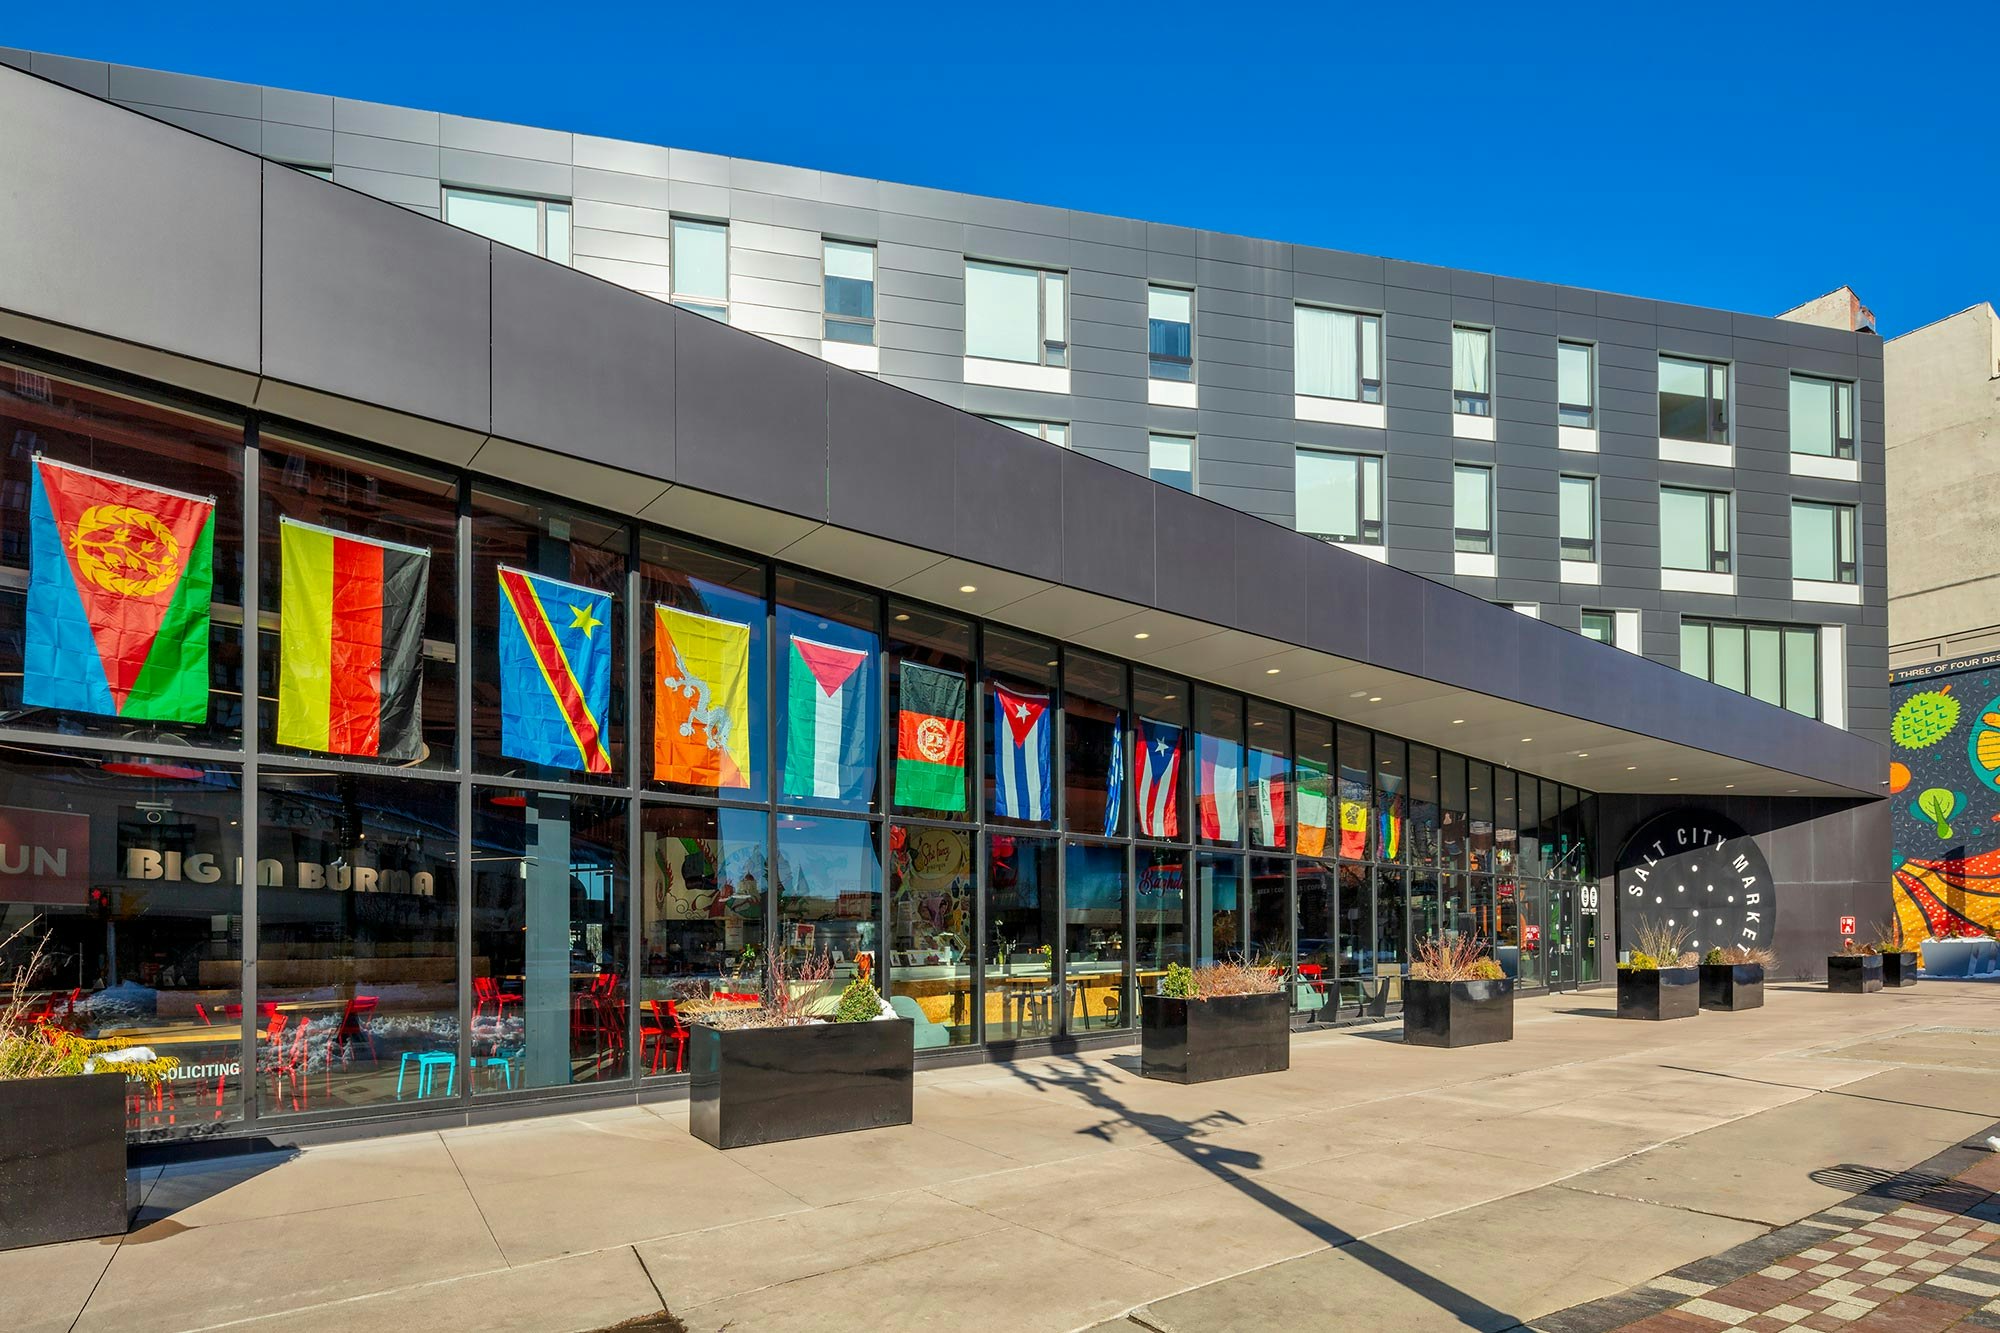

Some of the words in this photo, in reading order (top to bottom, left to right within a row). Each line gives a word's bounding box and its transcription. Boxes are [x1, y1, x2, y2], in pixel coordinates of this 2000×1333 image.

[1898, 667, 1932, 679] THREE
[1933, 664, 1949, 673] OF
[1950, 658, 1980, 670] FOUR
[127, 848, 222, 884] BIG
[298, 861, 434, 897] BURMA
[1628, 840, 1666, 897] SALT
[1677, 827, 1728, 852] CITY
[1732, 853, 1761, 957] MARKET
[160, 1062, 240, 1081] SOLICITING
